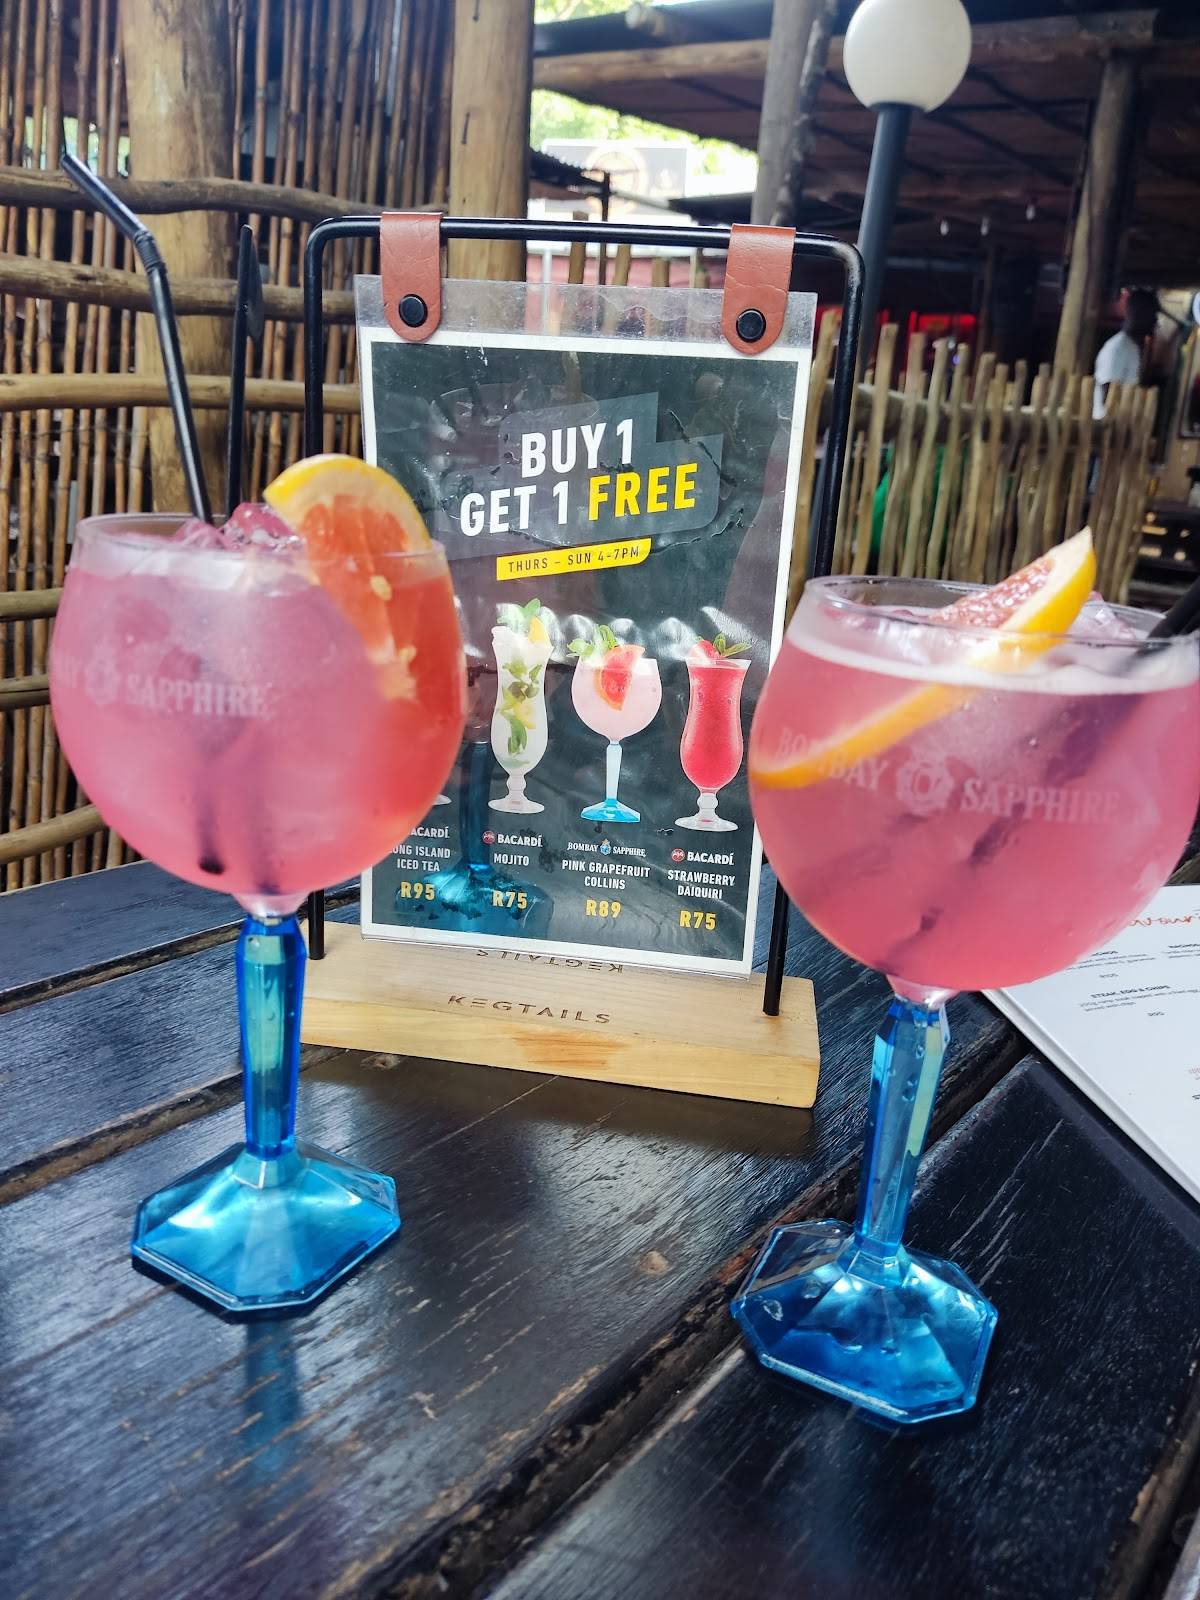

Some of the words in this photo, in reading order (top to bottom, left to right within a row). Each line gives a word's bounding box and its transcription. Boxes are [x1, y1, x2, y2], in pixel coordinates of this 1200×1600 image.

[521, 422, 607, 478] BUY
[616, 418, 633, 465] 1
[460, 485, 537, 537] GET
[552, 480, 569, 525] 1
[588, 462, 698, 521] FREE
[508, 556, 549, 574] THURS
[567, 551, 592, 566] SUN
[598, 545, 640, 562] 4-7PM
[125, 672, 270, 718] SAPPHIRE
[960, 777, 1120, 824] SAPPHIRE
[408, 826, 450, 839] ACARDÍ
[390, 844, 413, 855] ONG
[415, 846, 451, 859] ISLAND
[493, 853, 530, 866] MOJITO
[567, 842, 599, 852] BOMBAY
[612, 846, 647, 858] SAPPHIRE
[397, 858, 419, 870] ICED
[421, 861, 441, 872] TEA
[562, 859, 586, 872] PINK
[588, 862, 651, 878] GRAPEFRUIT
[584, 876, 626, 890] COLLINS
[667, 869, 736, 887] STRAWBERRY
[400, 881, 436, 900] R95
[492, 890, 528, 909] R75
[677, 885, 723, 900] DAIQUIRI
[585, 899, 622, 919] R89
[679, 910, 717, 930] R75
[447, 995, 611, 1024] KEGTAILS
